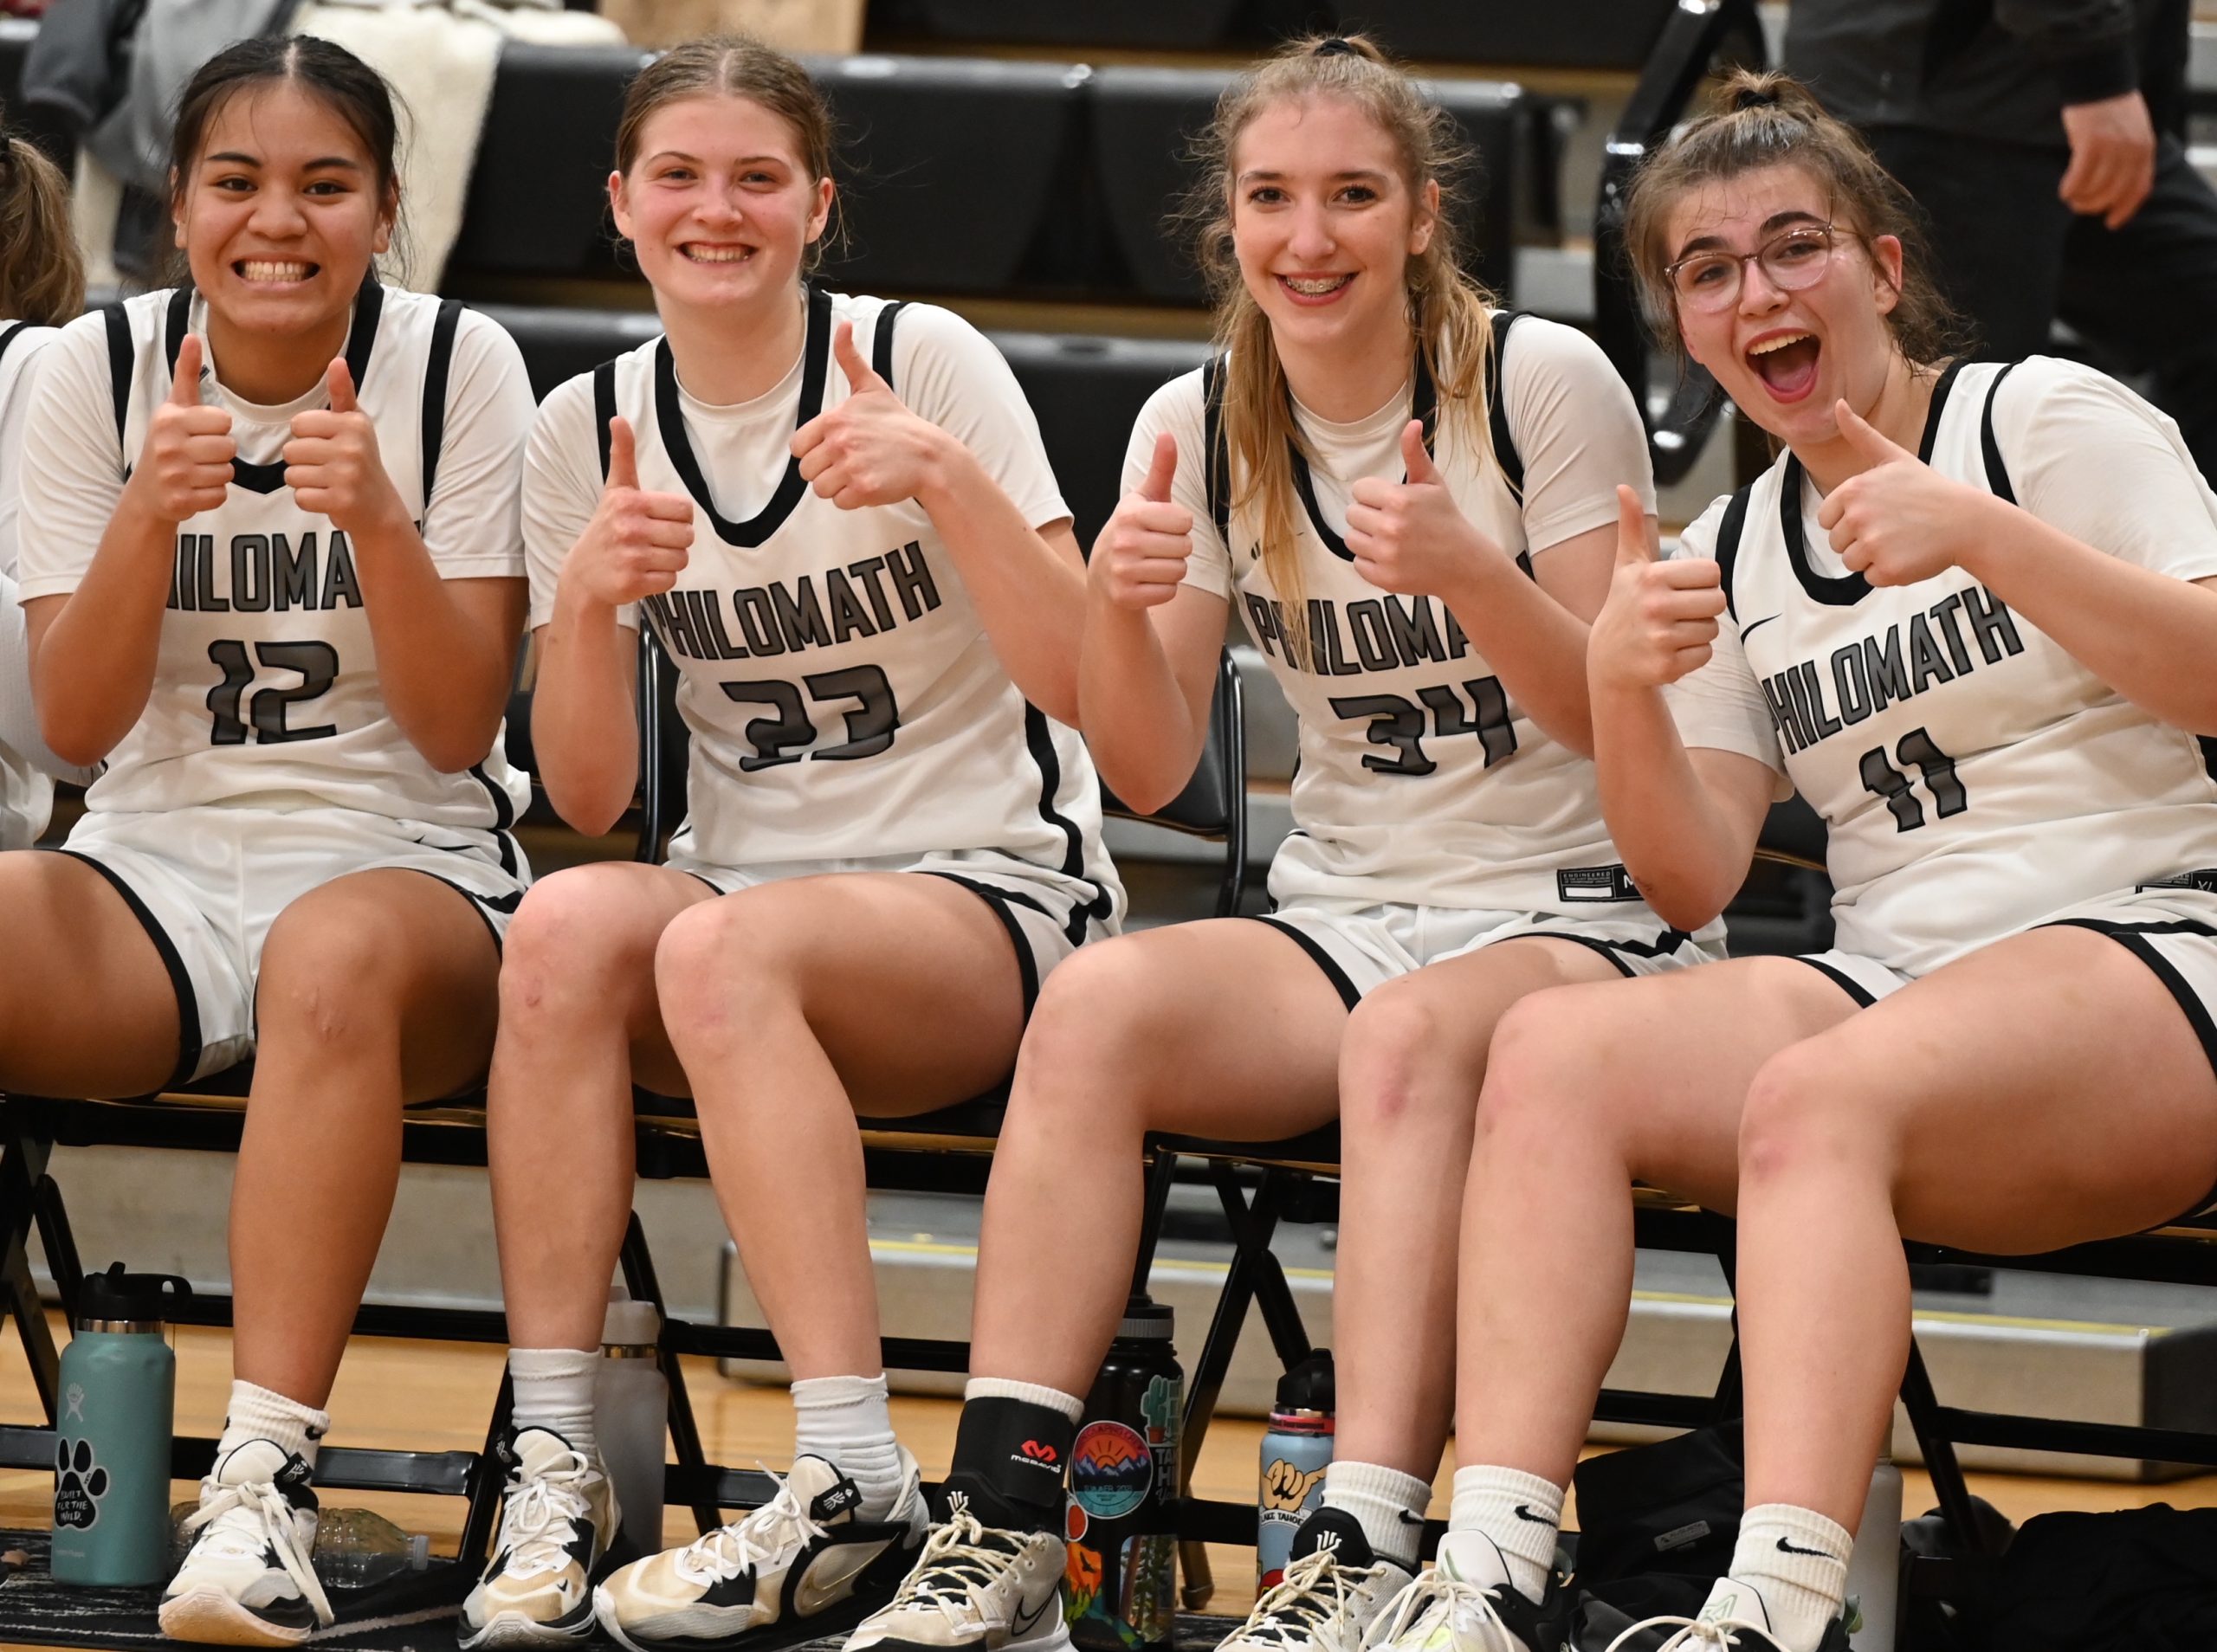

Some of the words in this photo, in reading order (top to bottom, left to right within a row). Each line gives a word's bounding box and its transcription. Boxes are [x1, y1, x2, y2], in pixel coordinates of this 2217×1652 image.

[165, 530, 365, 613] ILOMA
[206, 639, 339, 745] 12
[718, 663, 902, 772] 23
[1327, 674, 1518, 776] 34
[1761, 585, 2026, 760] HILOMATH
[1858, 726, 1968, 834] 11
